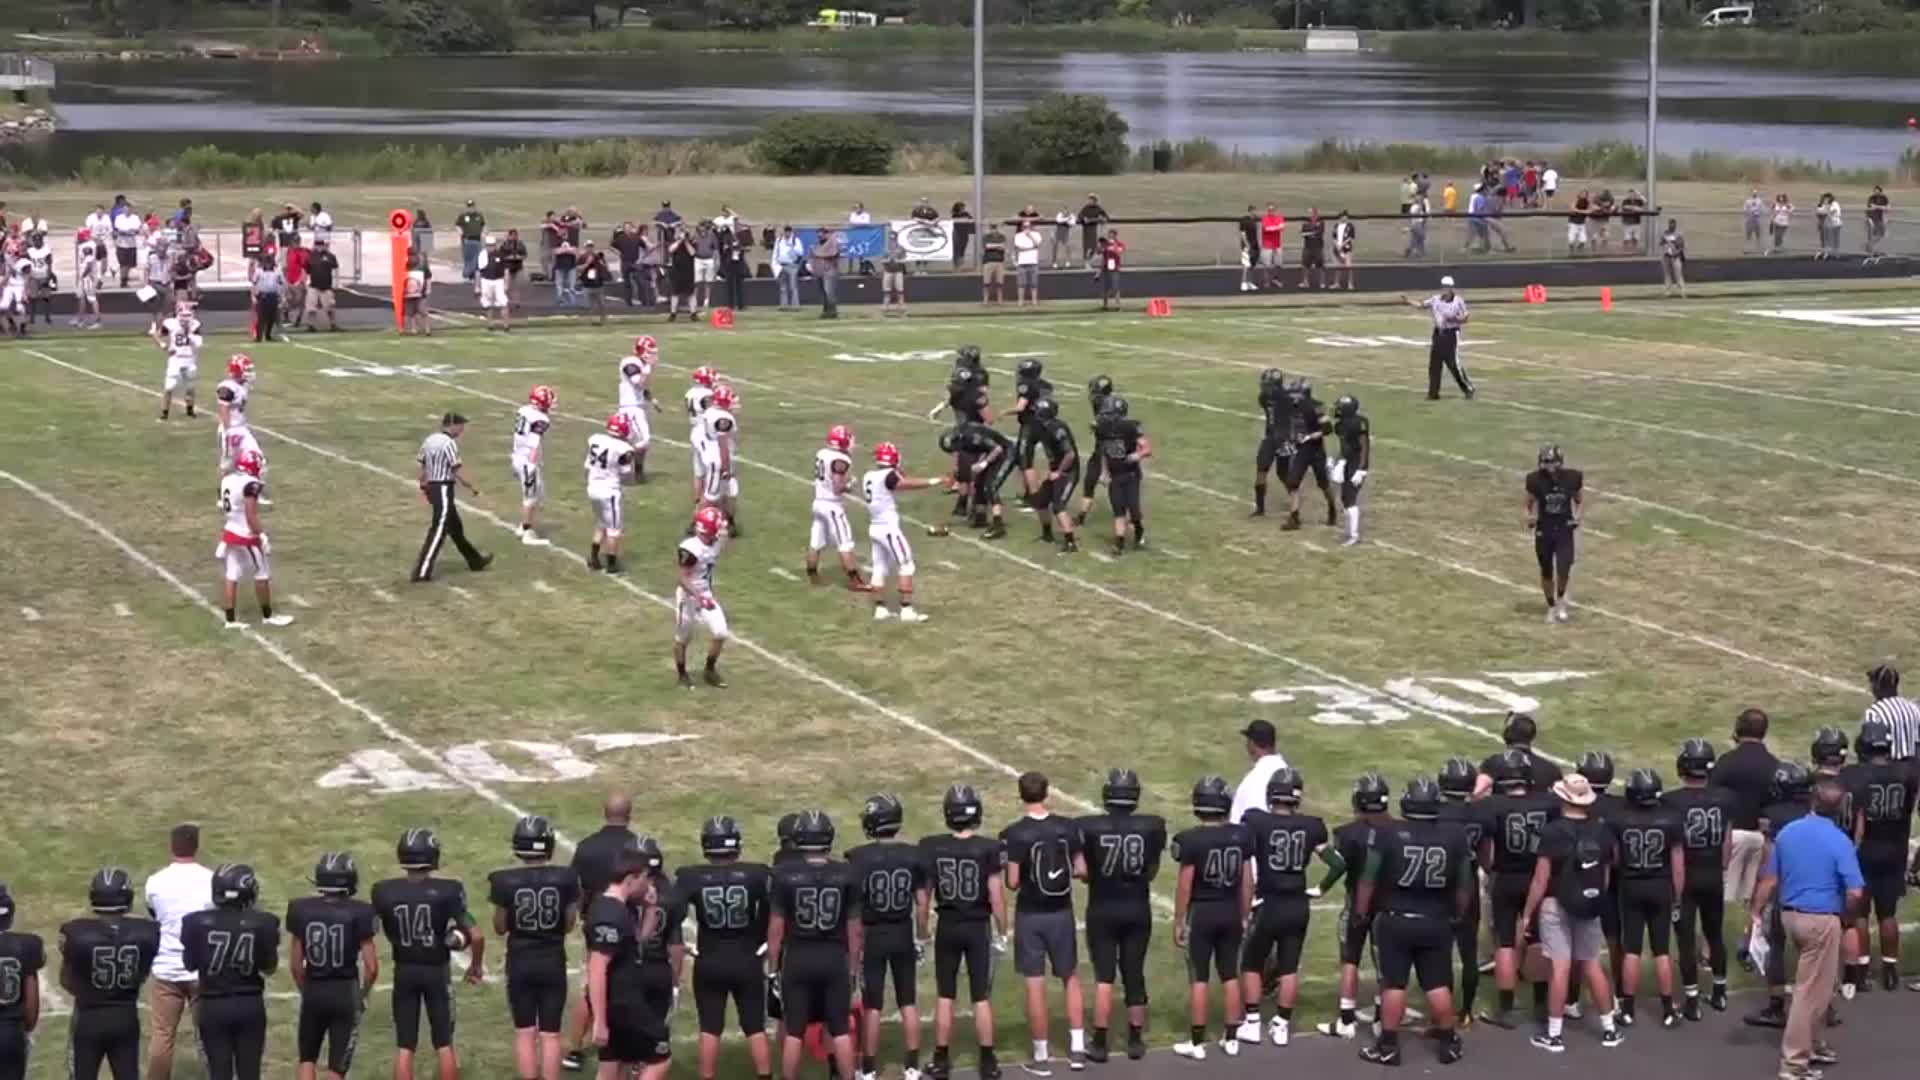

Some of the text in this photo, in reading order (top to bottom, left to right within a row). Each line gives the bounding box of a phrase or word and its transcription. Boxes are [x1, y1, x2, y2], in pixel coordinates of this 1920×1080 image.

[588, 443, 609, 470] 54
[1506, 811, 1547, 854] 67
[1622, 828, 1665, 869] 32
[1684, 807, 1722, 848] 21
[1099, 833, 1146, 877] 78
[1203, 846, 1243, 888] 40
[1267, 830, 1308, 872] 31
[1398, 846, 1447, 889] 72
[868, 869, 913, 914] 88
[936, 857, 981, 902] 58
[393, 904, 435, 948] 14
[513, 886, 561, 931] 28
[702, 885, 750, 930] 52
[796, 887, 842, 930] 59
[206, 931, 256, 976] 74
[304, 921, 346, 968] 81
[91, 945, 141, 990] 53
